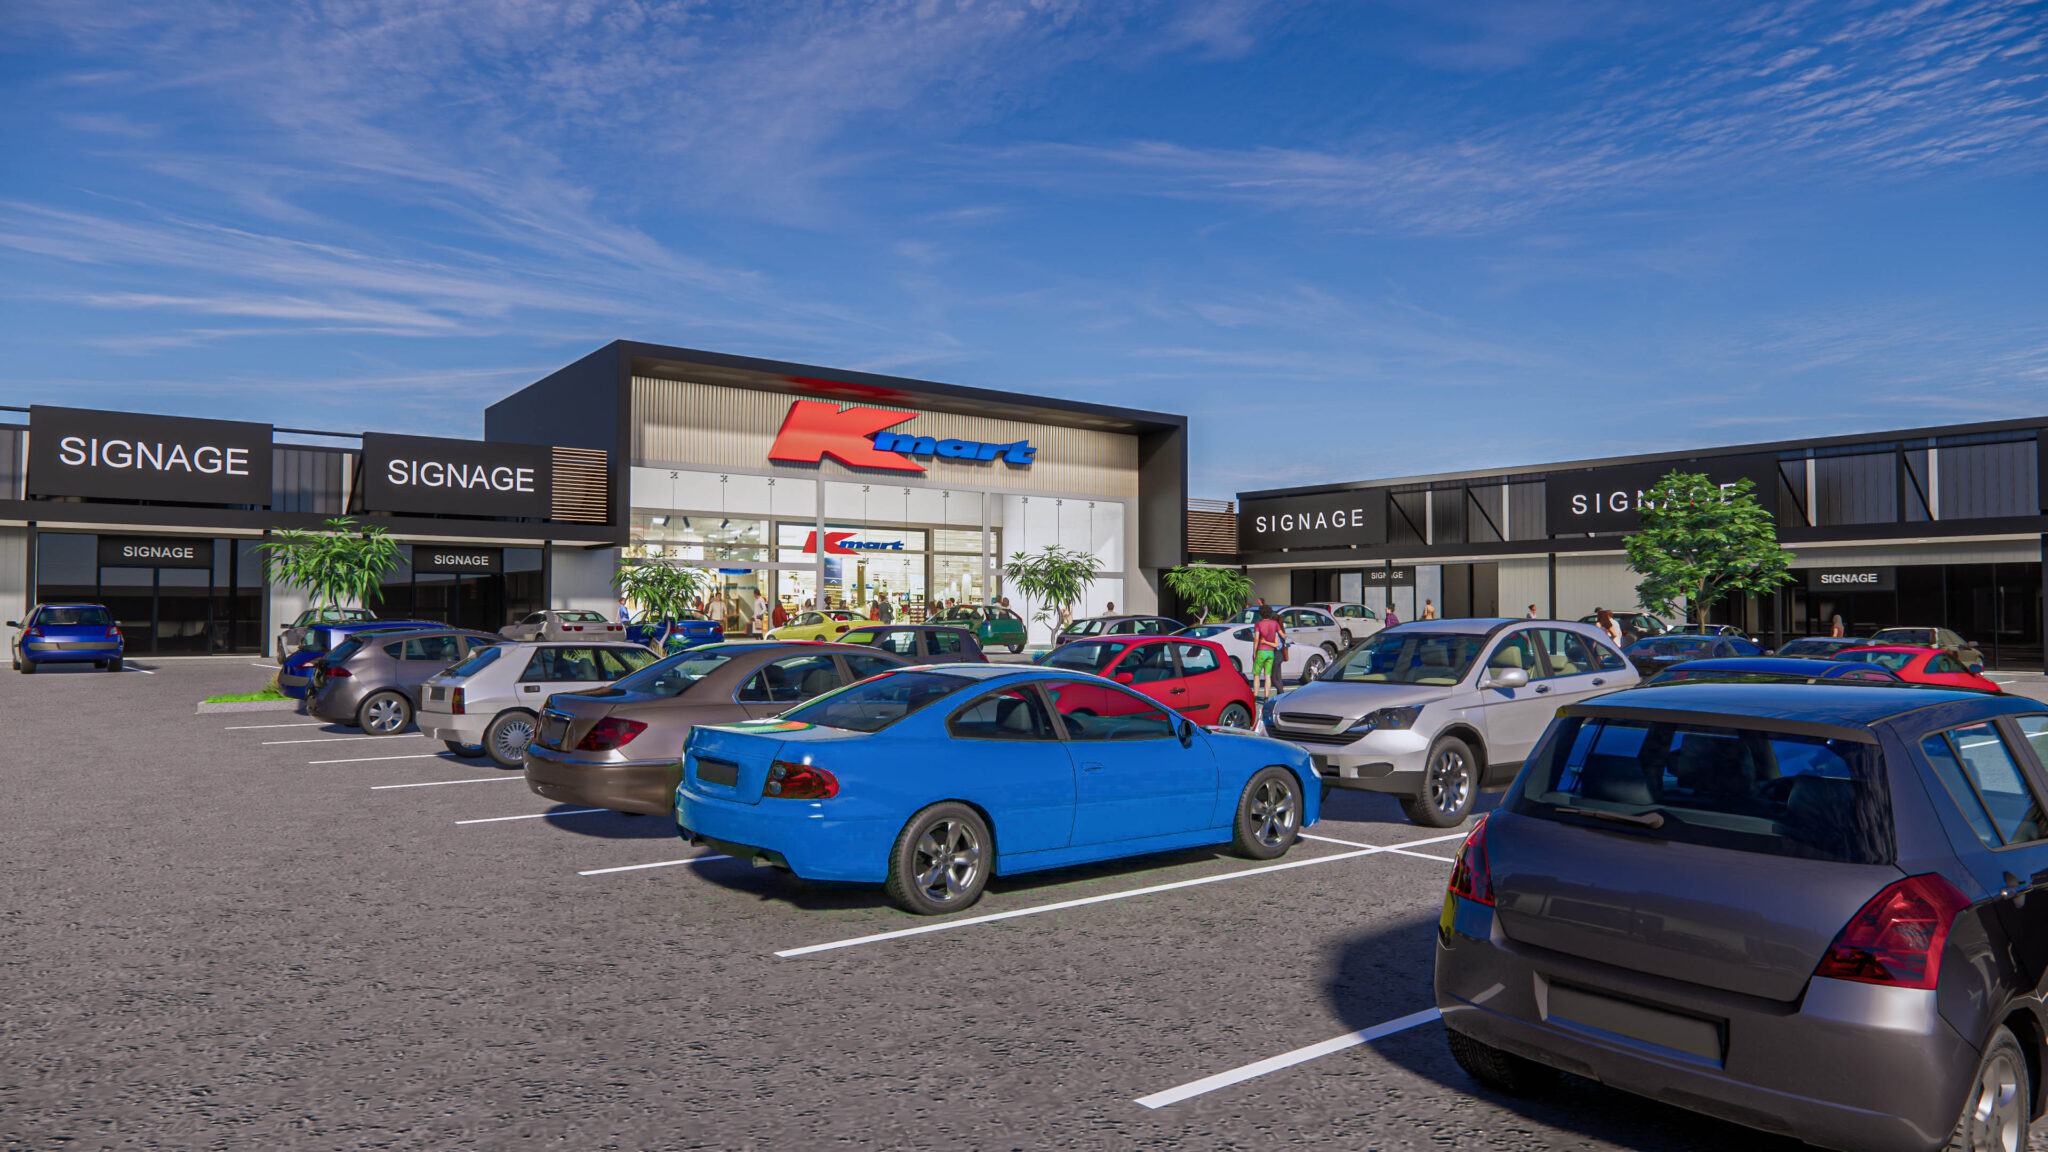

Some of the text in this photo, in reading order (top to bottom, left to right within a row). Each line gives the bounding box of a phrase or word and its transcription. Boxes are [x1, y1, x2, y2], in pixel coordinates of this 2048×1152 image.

[767, 399, 1037, 472] Kmart
[59, 436, 250, 476] SIGNAGE
[387, 459, 535, 493] SIGNAGE
[1256, 508, 1364, 533] SIGNAGE
[123, 545, 194, 559] SIGNAGE
[802, 531, 905, 556] Kmart
[434, 554, 489, 566] SIGNAGE
[1371, 571, 1404, 580] SIGNGE
[1820, 573, 1878, 584] SIGNAGE
